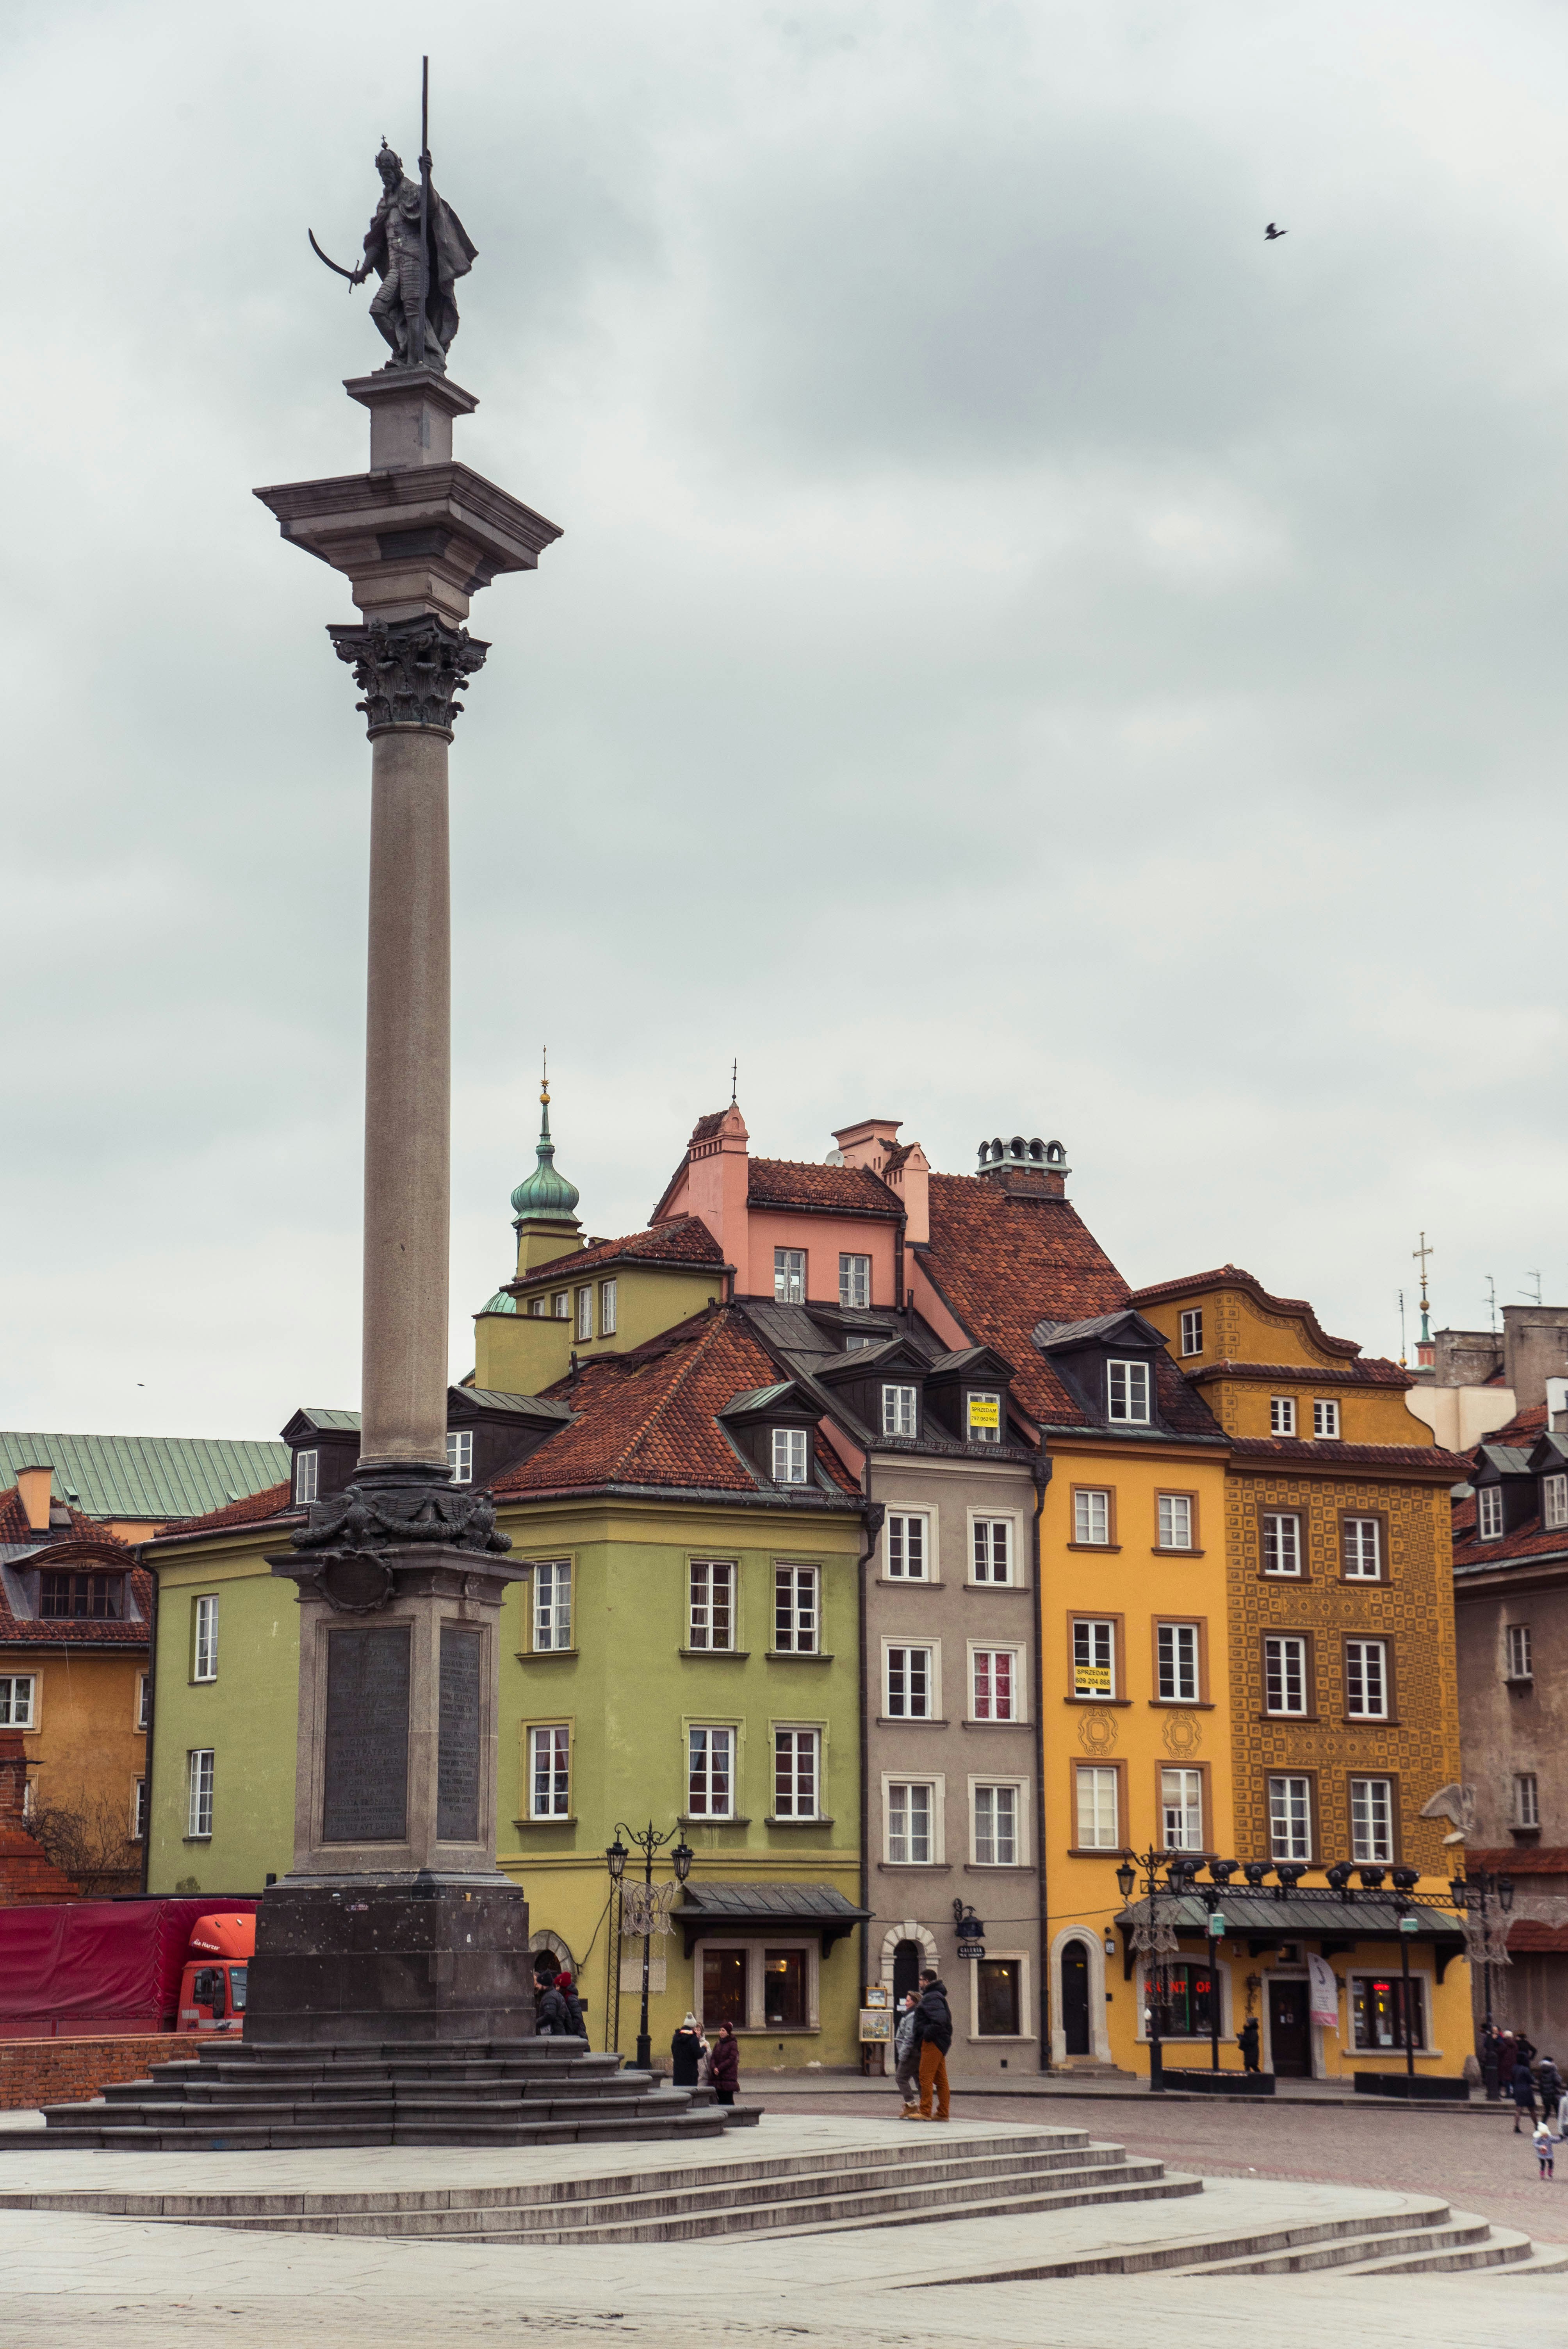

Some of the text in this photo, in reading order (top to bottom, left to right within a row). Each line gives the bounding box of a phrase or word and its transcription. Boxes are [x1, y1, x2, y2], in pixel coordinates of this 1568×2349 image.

[440, 1658, 472, 1669] IGISMVNDVS
[362, 1748, 399, 1756] PATRIAE
[201, 1941, 220, 1951] Harzer
